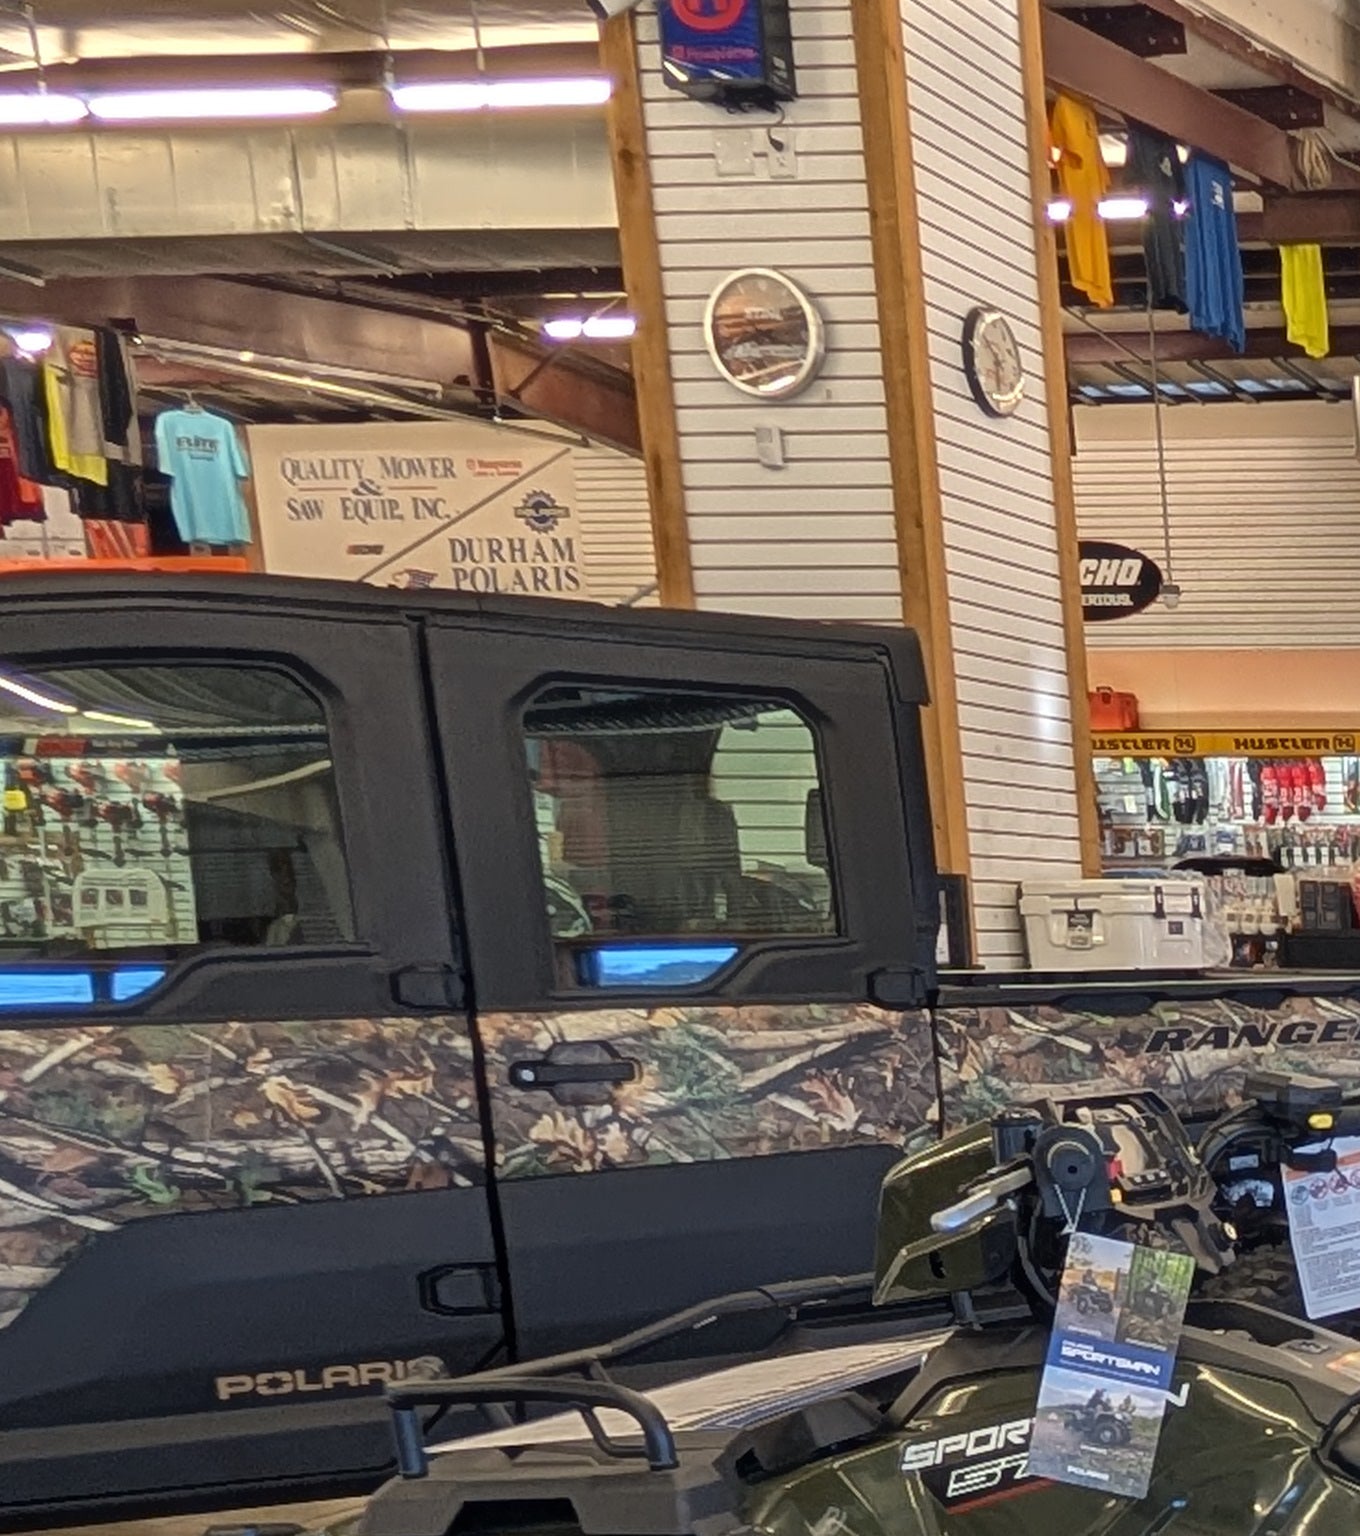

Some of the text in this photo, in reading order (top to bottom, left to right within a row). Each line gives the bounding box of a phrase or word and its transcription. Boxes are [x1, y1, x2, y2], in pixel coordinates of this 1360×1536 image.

[281, 456, 457, 485] QUALITY MOWER
[351, 478, 383, 497] &
[287, 496, 325, 521] SAW
[448, 537, 577, 565] DURHAM
[452, 565, 581, 594] POLARIS
[1080, 558, 1143, 587] CHO
[1091, 738, 1171, 751] USTLER
[1233, 737, 1331, 751] HUSTLER
[1060, 1346, 1162, 1377] SPORTSMAN
